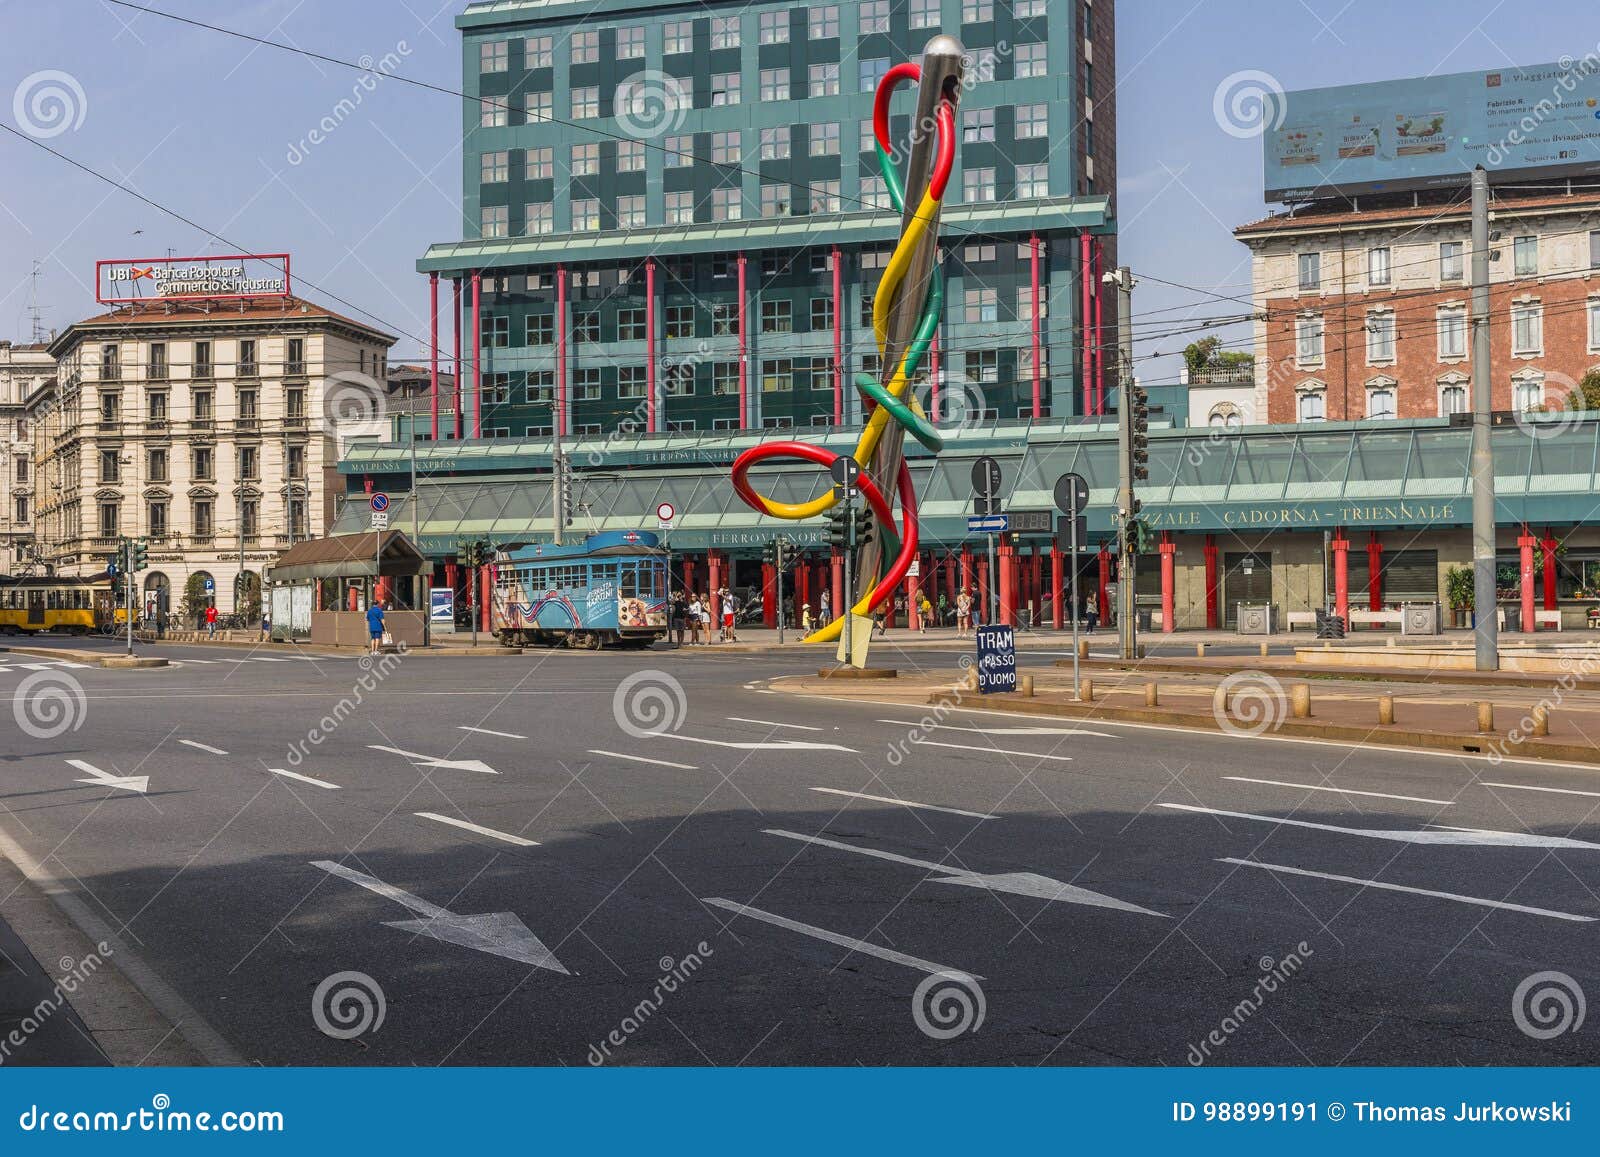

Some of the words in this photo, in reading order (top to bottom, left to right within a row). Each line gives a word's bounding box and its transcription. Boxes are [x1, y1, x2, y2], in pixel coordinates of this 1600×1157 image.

[1487, 100, 1517, 108] Fabrizio
[108, 269, 130, 281] UBI
[154, 267, 188, 279] Banca
[190, 265, 240, 279] Popolare
[154, 280, 220, 293] Commercio
[352, 463, 400, 472] MALPENSA
[416, 461, 456, 470] EXPRESS
[1111, 511, 1200, 526] PZZALE
[1224, 508, 1319, 524] CADORNA
[1339, 505, 1455, 521] TRIENNALE
[713, 532, 778, 545] FERROVI
[978, 631, 1013, 649] TRAM
[984, 654, 1015, 667] PASSO
[979, 672, 1016, 686] D'UOMO
